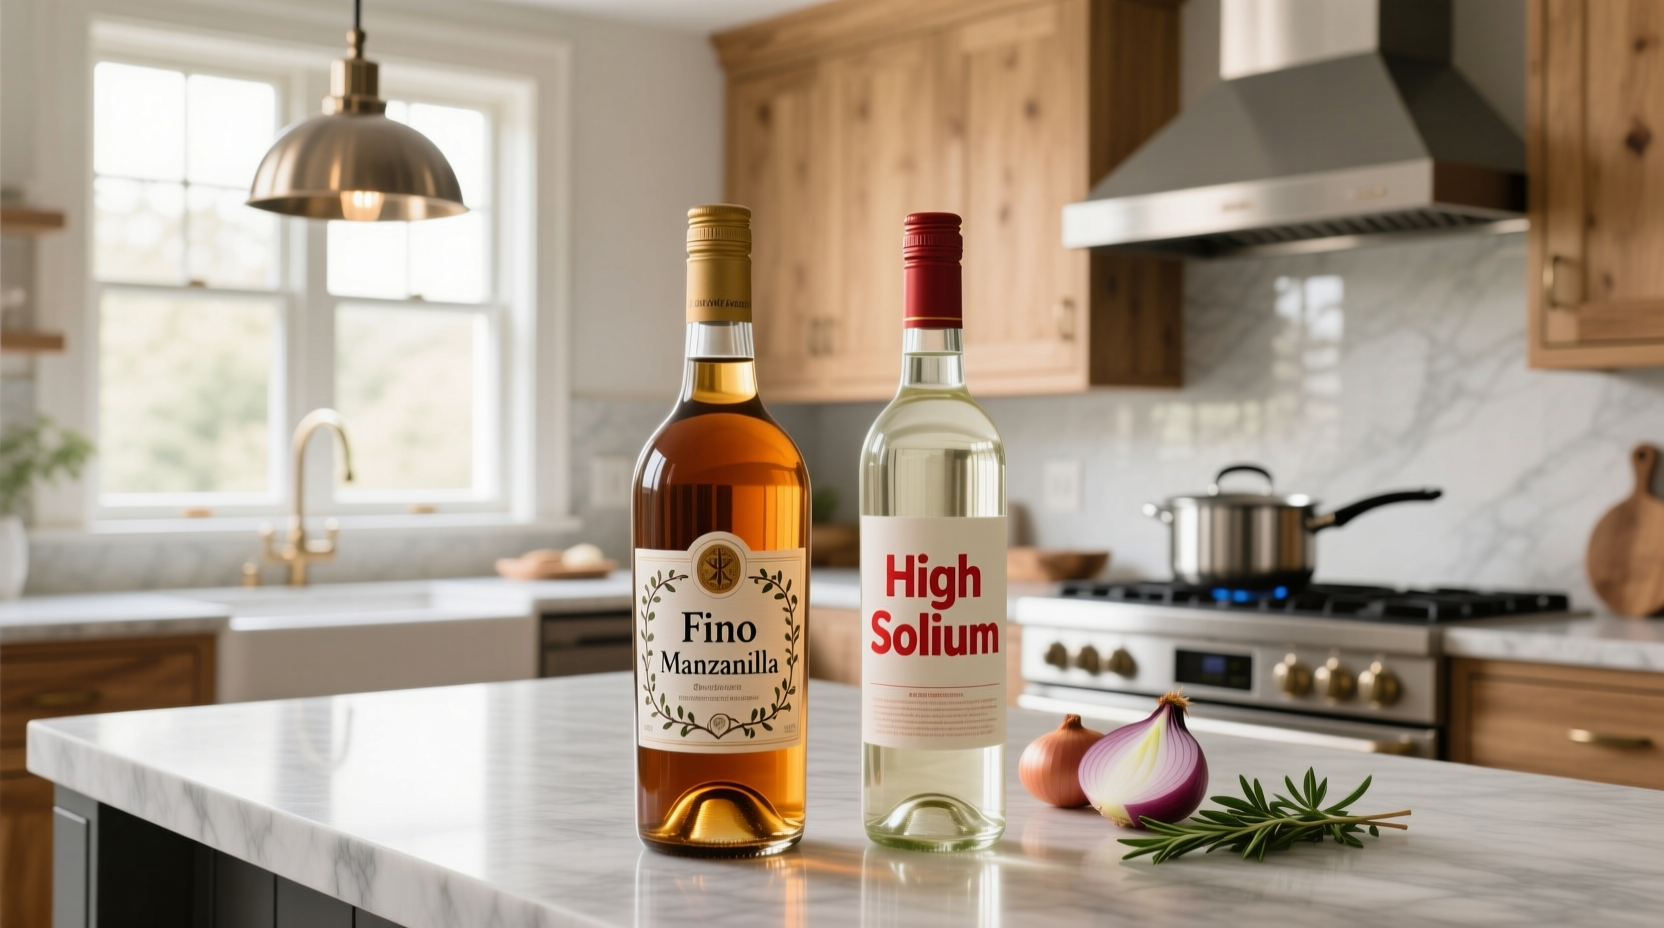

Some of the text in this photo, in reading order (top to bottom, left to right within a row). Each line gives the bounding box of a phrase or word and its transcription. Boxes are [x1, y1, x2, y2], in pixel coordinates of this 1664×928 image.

[886, 553, 981, 610] High
[681, 611, 757, 643] Fino
[871, 610, 999, 657] Solium
[660, 649, 779, 675] Manzanilla
